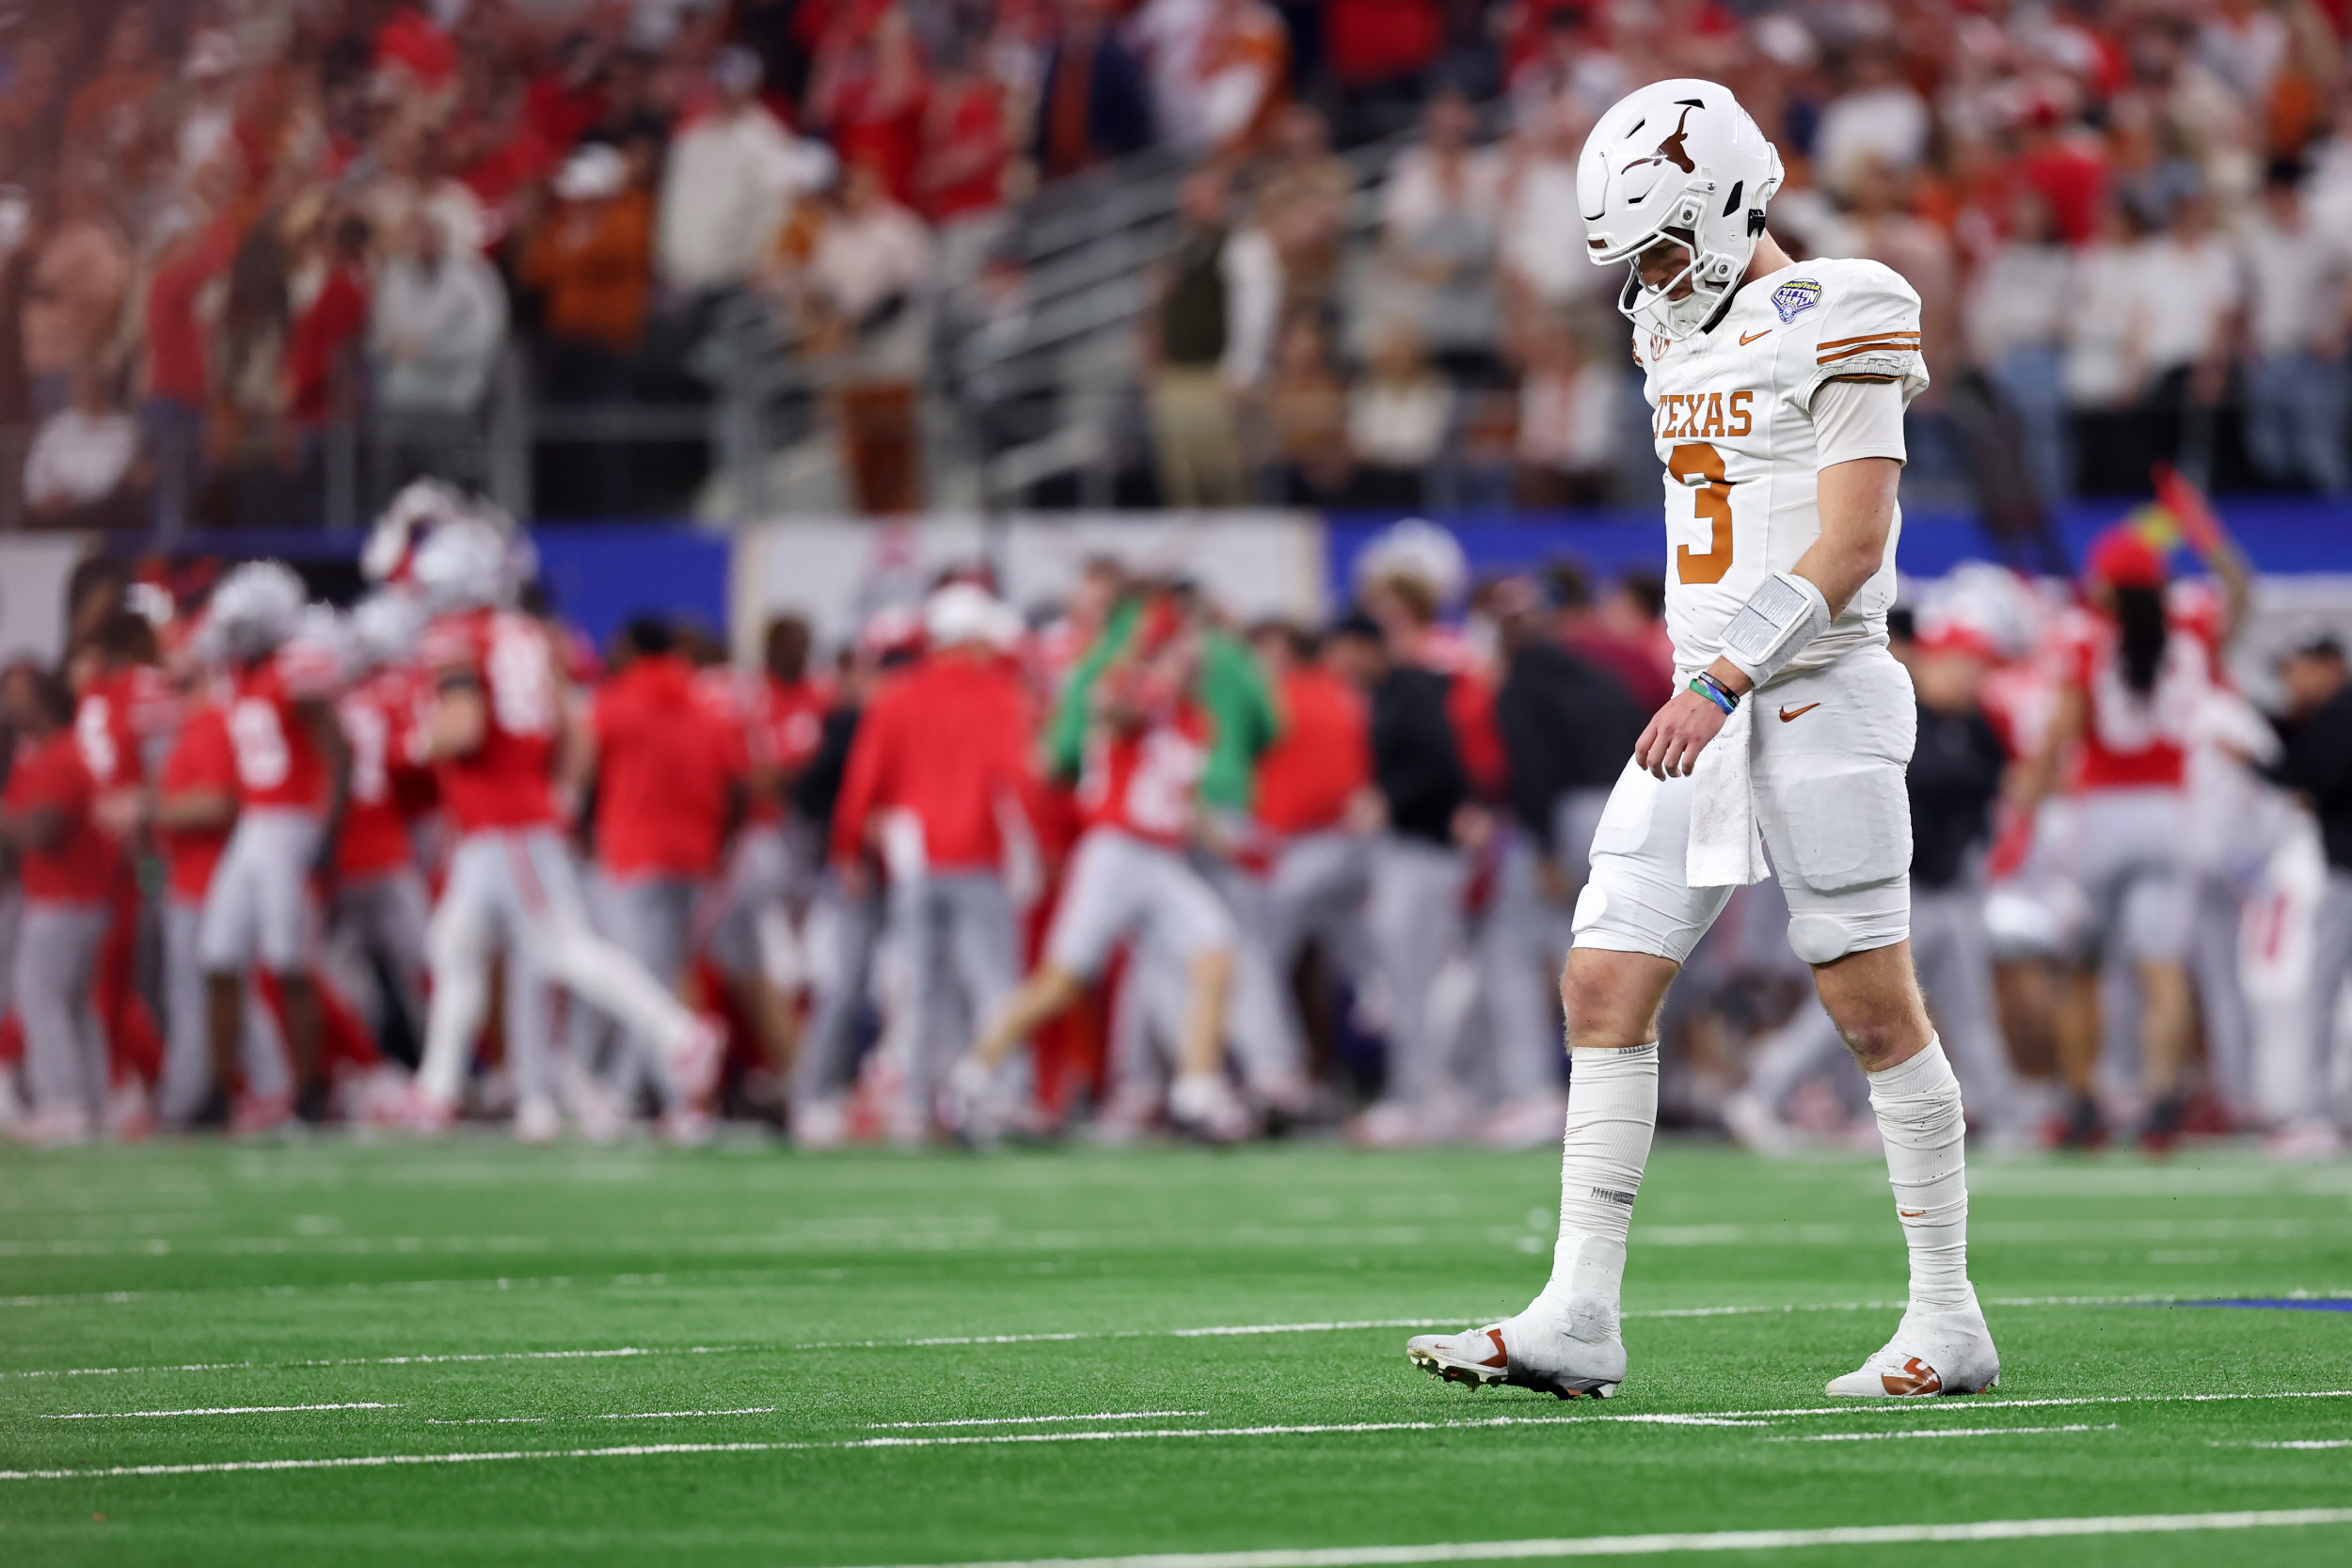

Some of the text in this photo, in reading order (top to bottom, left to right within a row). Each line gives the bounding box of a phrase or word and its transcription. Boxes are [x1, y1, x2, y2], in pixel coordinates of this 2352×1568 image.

[1774, 288, 1819, 303] COTTON
[1780, 295, 1805, 307] BOWL
[1654, 391, 1754, 438] TEXAS
[1667, 442, 1735, 585] 3
